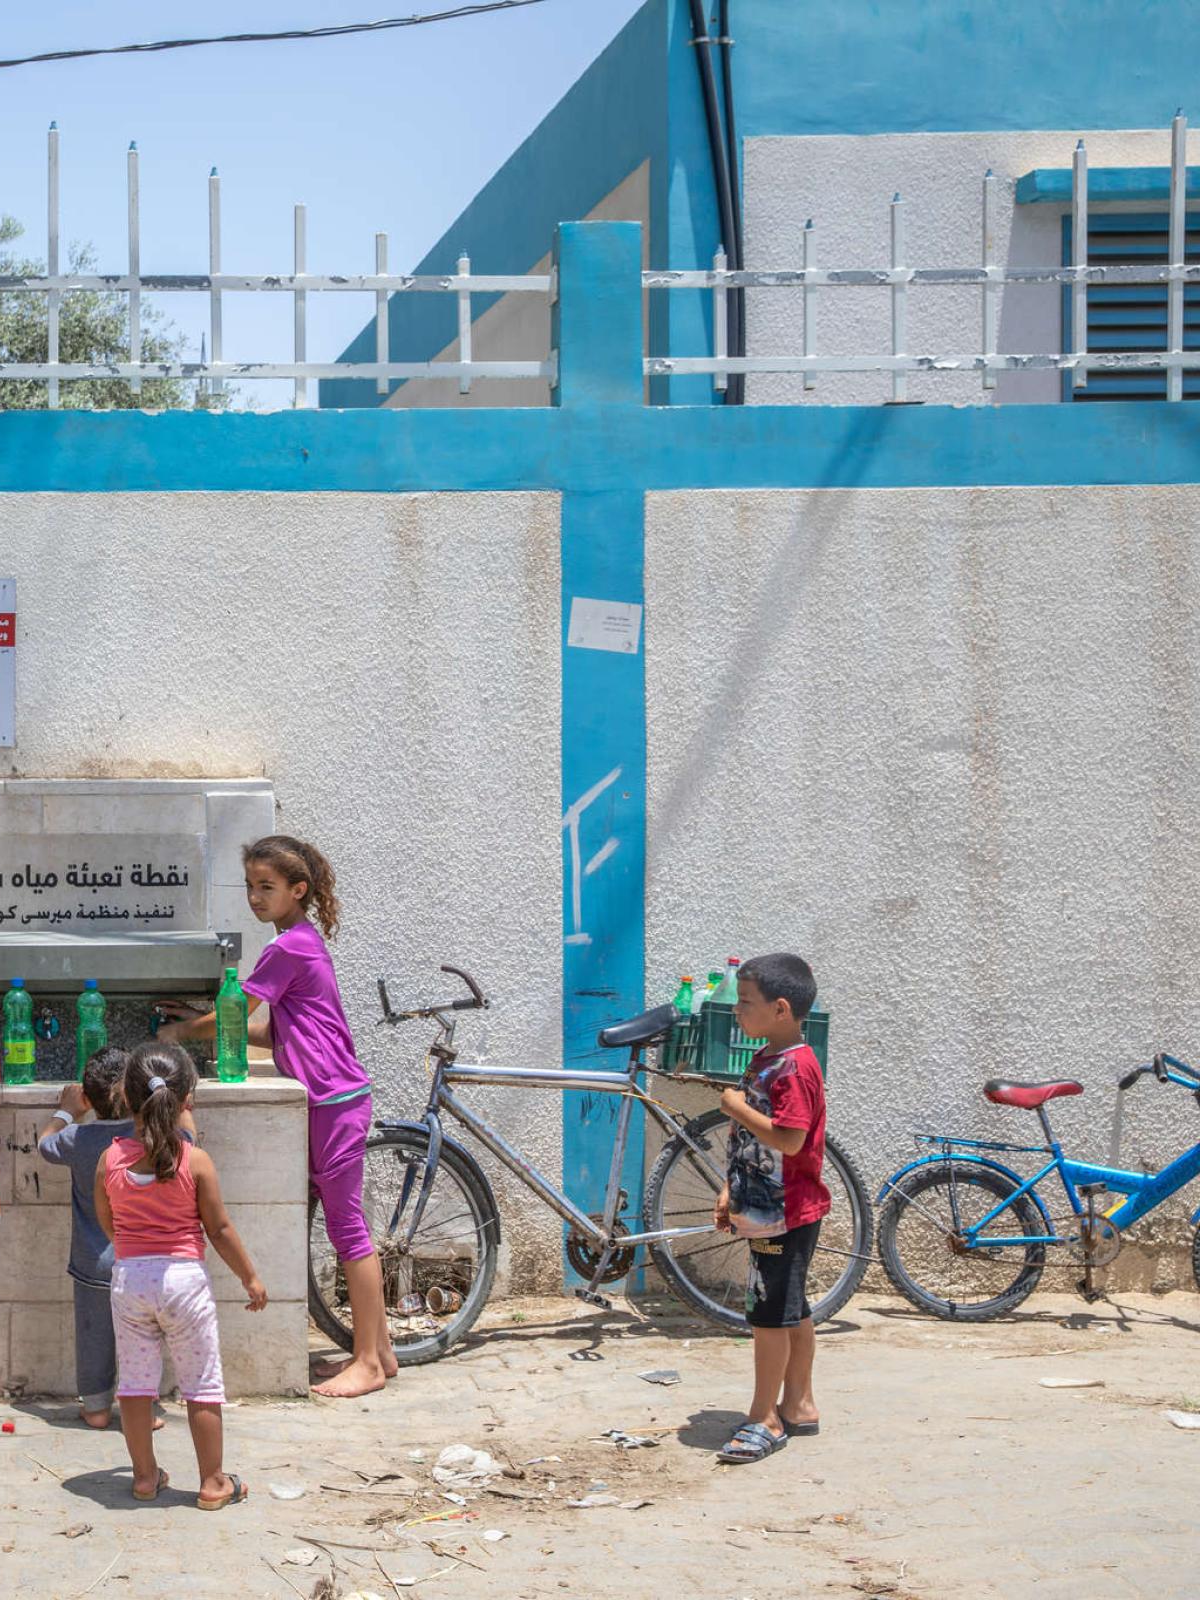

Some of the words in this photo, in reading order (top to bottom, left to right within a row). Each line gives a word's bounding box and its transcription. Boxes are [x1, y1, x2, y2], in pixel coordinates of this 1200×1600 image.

[11, 864, 58, 894] مياه
[66, 862, 123, 894] تعبئة
[130, 863, 188, 887] نقطة
[76, 903, 130, 920] منظمة
[133, 904, 175, 923] تنفيذ
